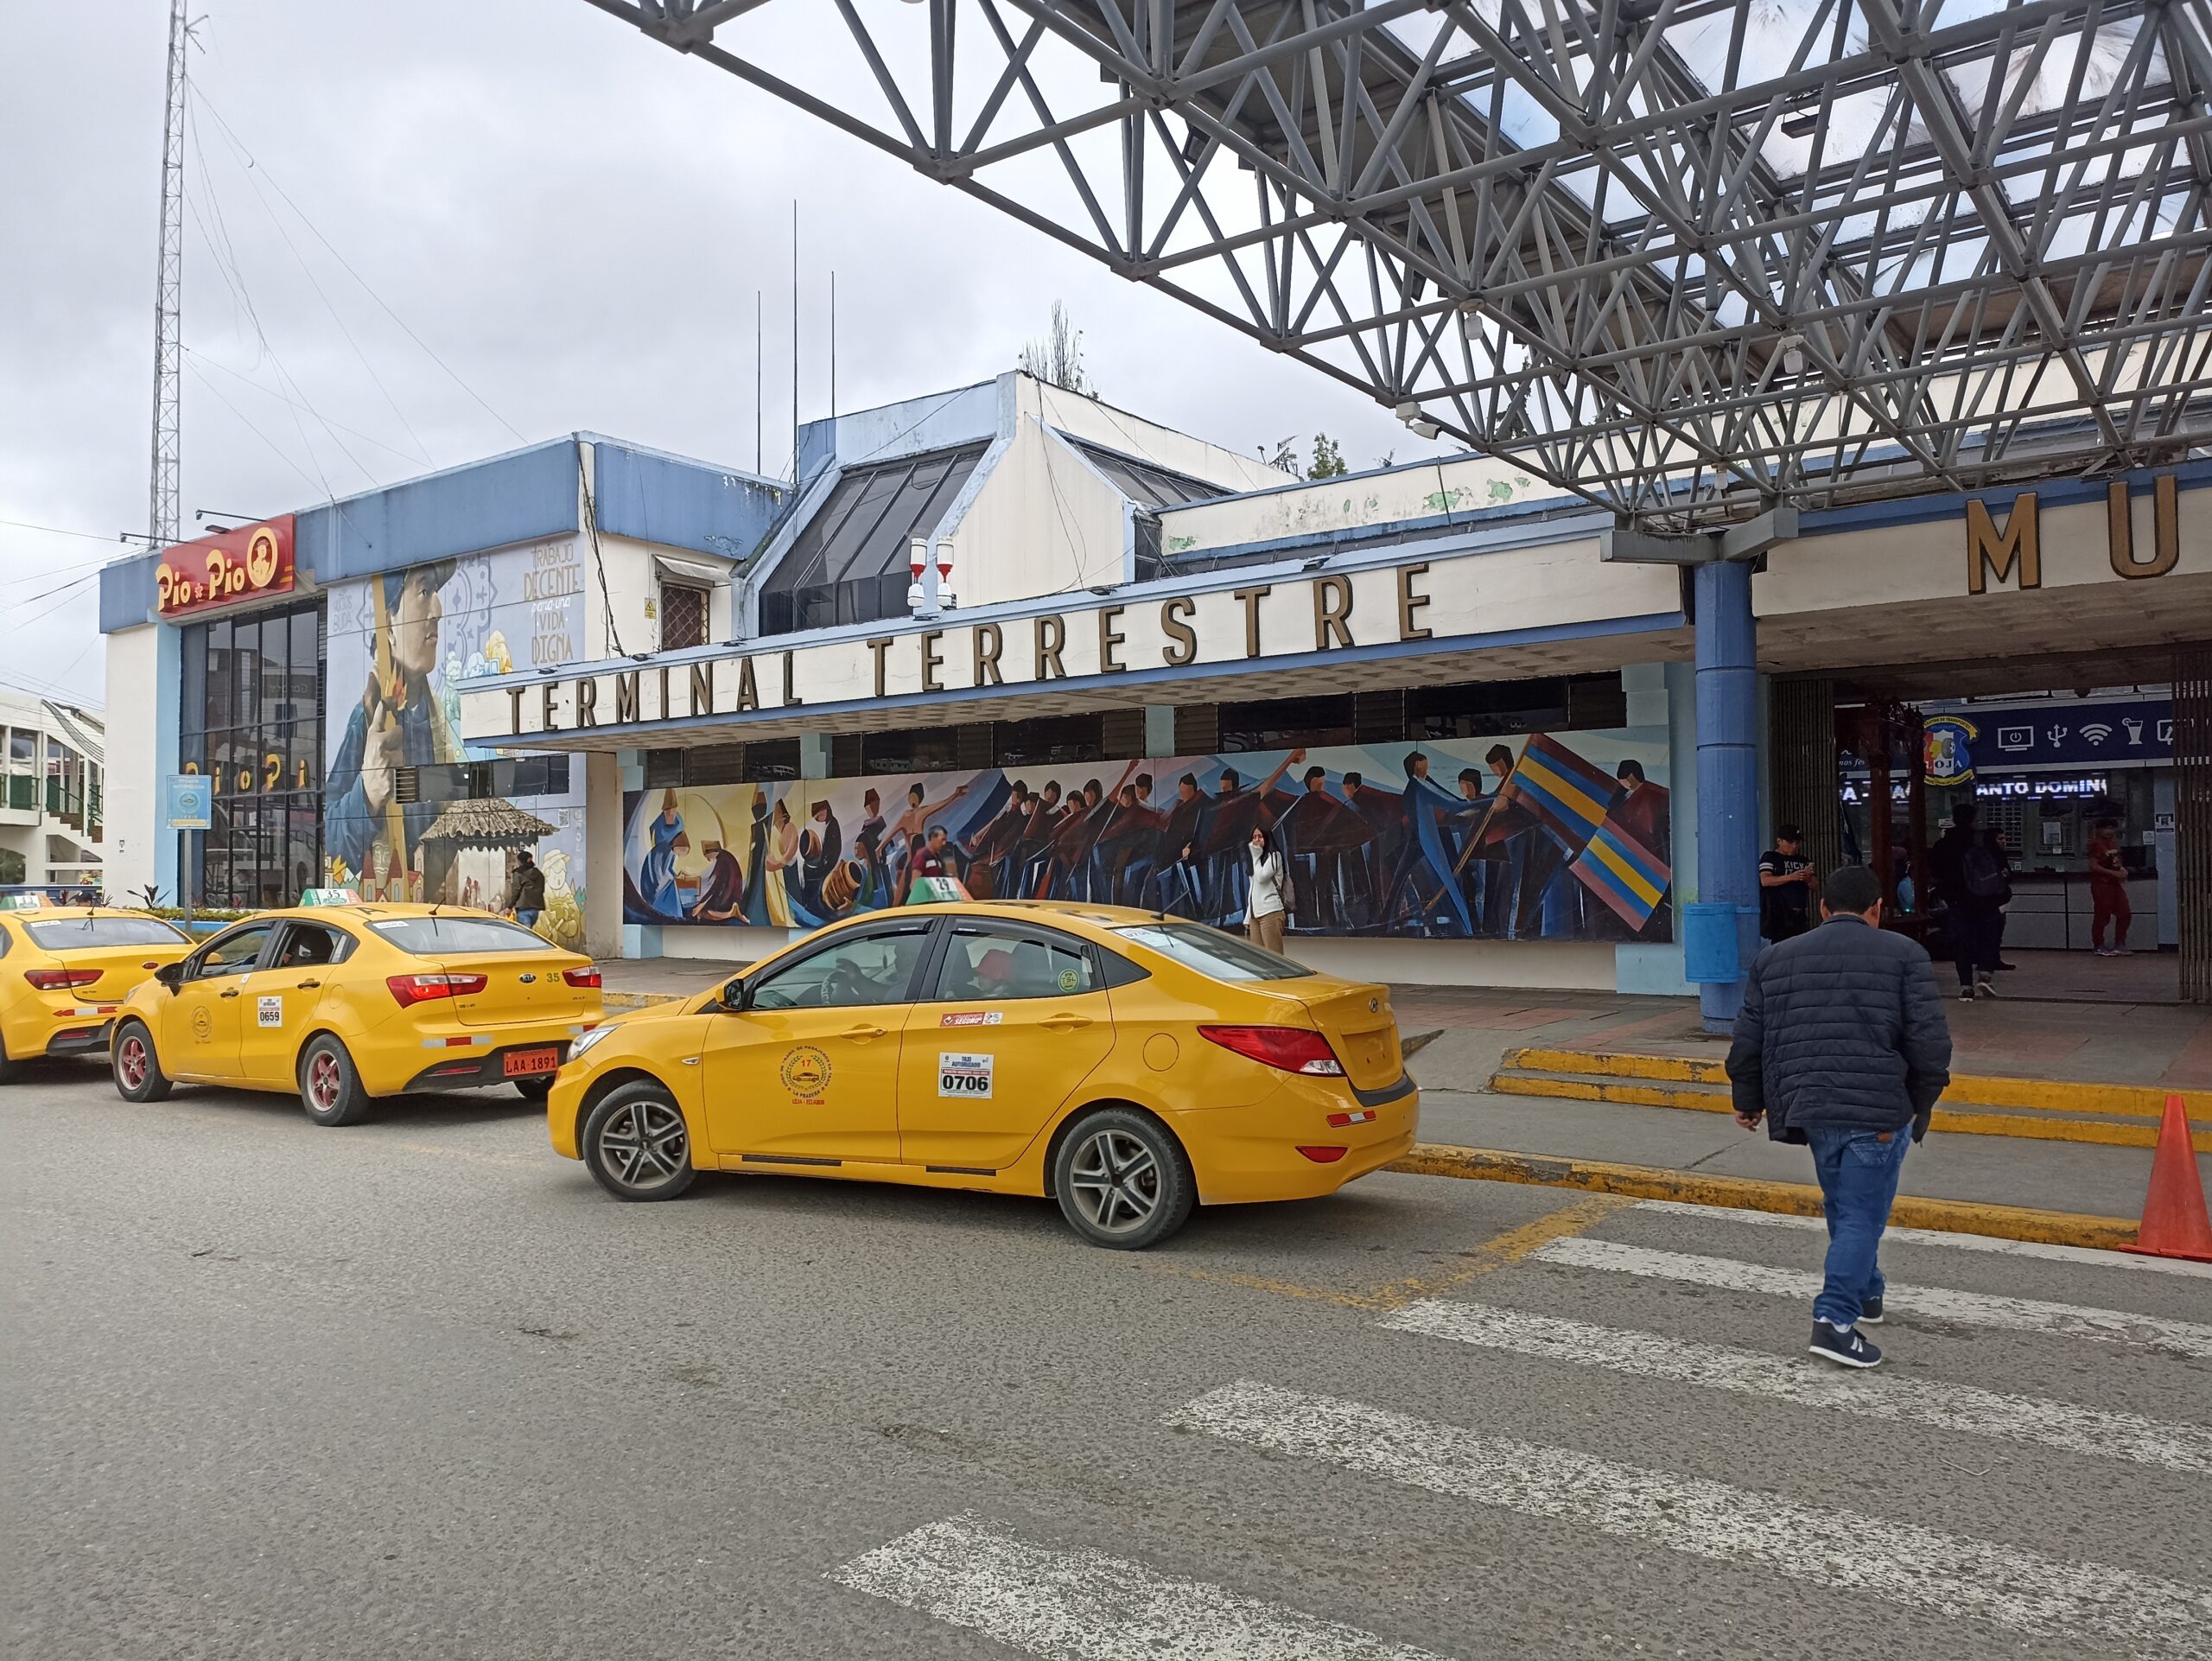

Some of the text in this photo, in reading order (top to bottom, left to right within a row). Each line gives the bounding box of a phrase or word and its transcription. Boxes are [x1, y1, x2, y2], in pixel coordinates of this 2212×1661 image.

[156, 549, 245, 612] Pio Pio
[524, 563, 581, 601] DECENTE
[539, 610, 565, 632] VIDA
[506, 562, 1433, 735] TERMINAL TERRESTRE
[531, 633, 574, 665] DIGNA
[1925, 760, 1963, 769] LOJA
[936, 878, 950, 891] 29
[327, 889, 340, 899] 35
[522, 973, 535, 982] KIA
[546, 972, 560, 983] 35
[259, 1011, 280, 1021] 0659
[943, 1075, 988, 1091] 0706
